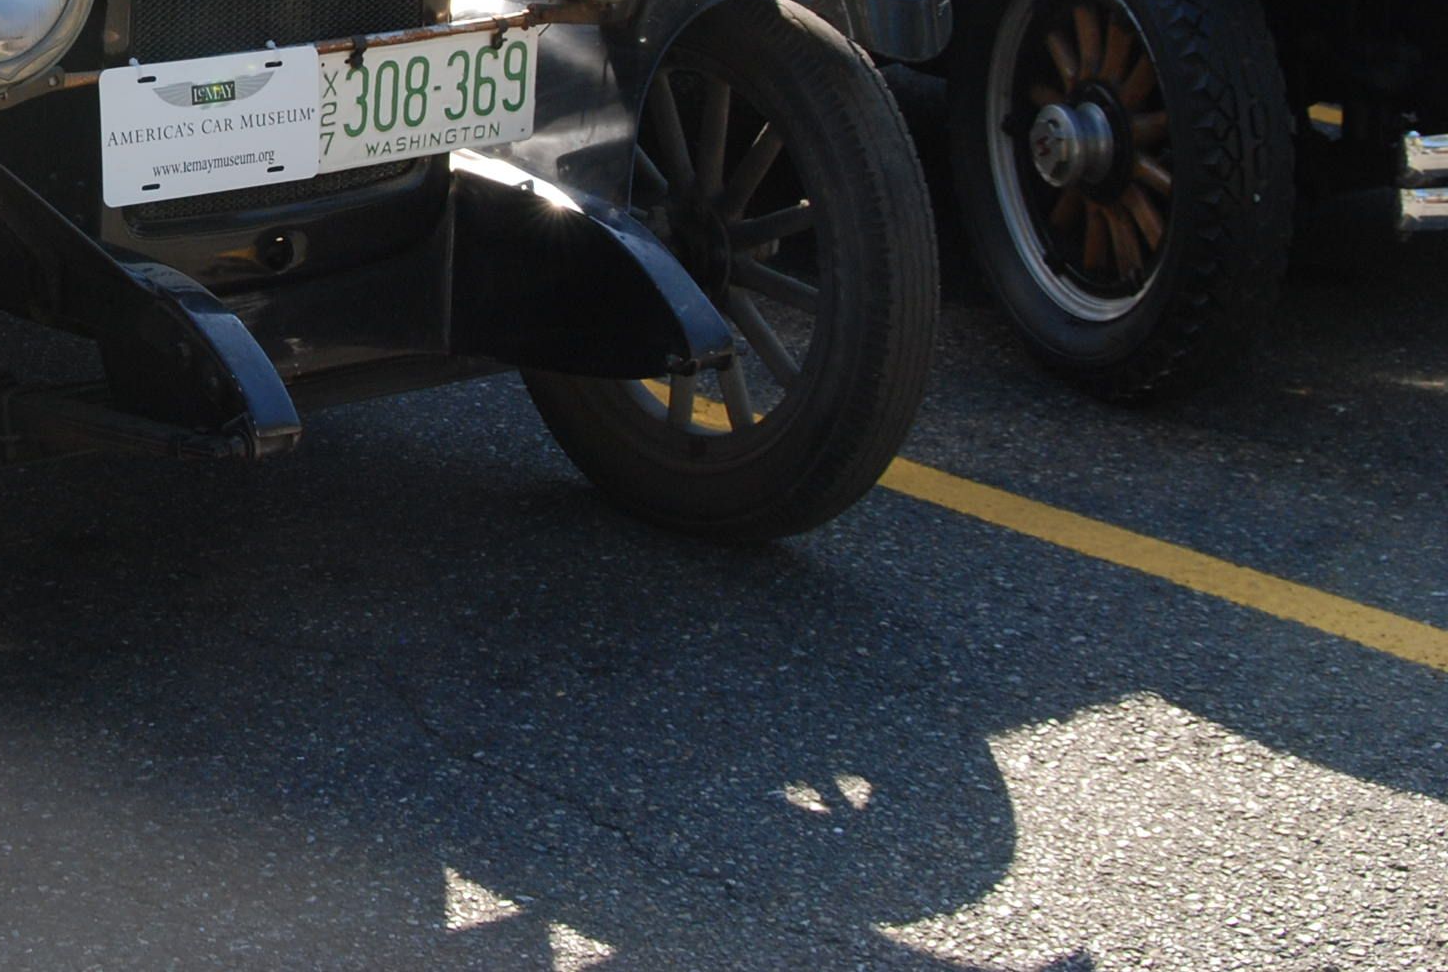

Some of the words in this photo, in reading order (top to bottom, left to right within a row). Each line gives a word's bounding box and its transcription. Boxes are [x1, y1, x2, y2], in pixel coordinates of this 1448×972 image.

[343, 40, 528, 137] 308-369
[107, 121, 195, 147] AMERICA'S
[201, 117, 234, 135] CAR
[240, 107, 313, 130] MUSEUM
[365, 122, 501, 157] WASHINGTON
[152, 150, 275, 178] www.lemaymuseum.org
